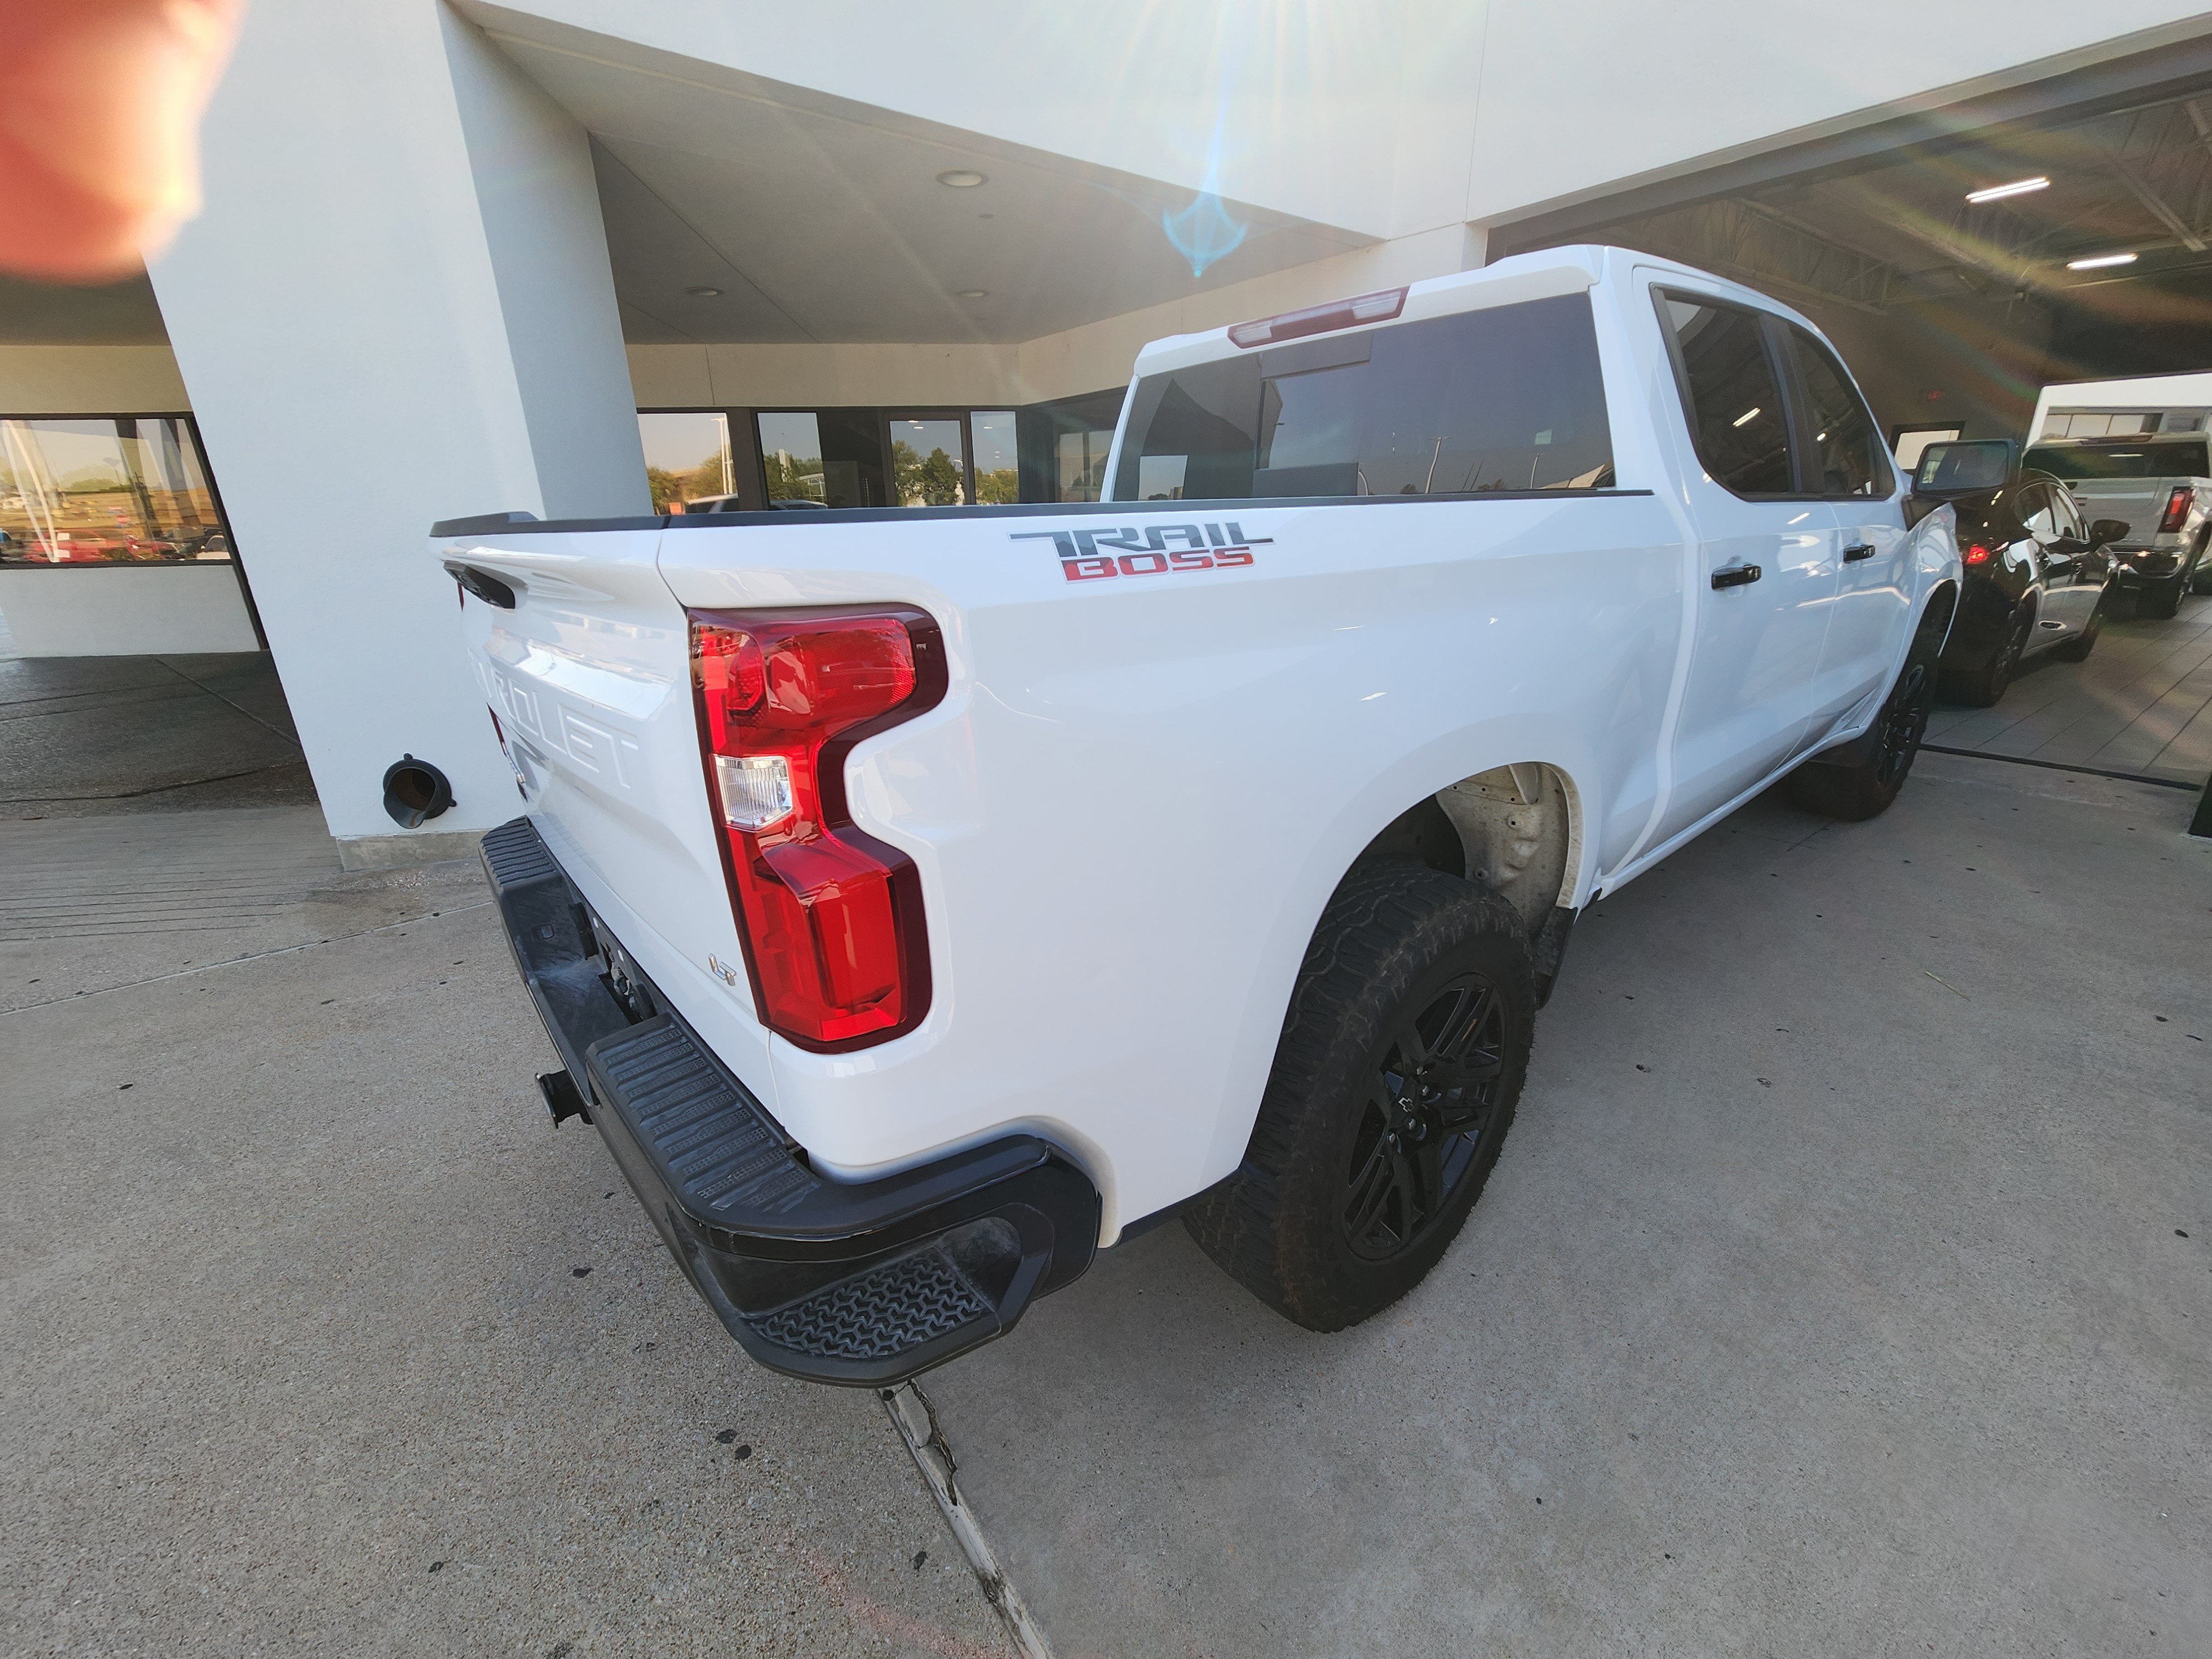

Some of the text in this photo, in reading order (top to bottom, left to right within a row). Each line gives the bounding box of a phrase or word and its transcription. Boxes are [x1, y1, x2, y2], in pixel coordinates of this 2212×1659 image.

[1008, 521, 1275, 557] TRAIL
[1060, 545, 1255, 582] BOSS
[708, 953, 737, 987] LT
